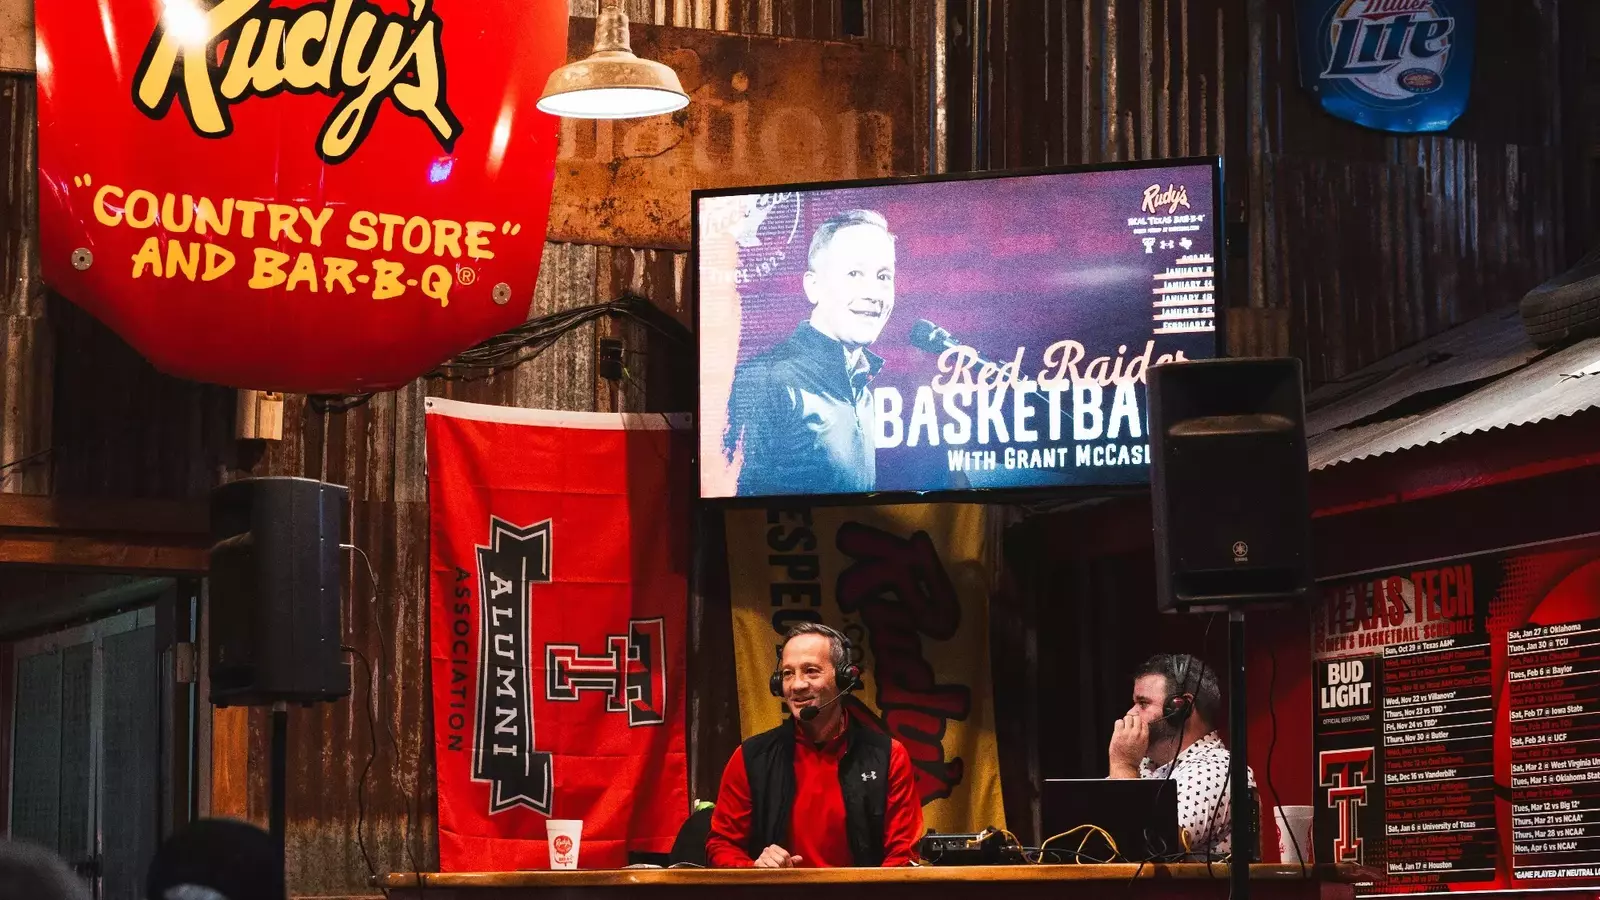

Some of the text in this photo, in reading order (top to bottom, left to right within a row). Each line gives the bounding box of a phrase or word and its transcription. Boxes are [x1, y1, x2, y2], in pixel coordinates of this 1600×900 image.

[1320, 15, 1456, 79] Lite
[1141, 183, 1191, 214] Rudy's
[131, 236, 236, 282] AND
[931, 344, 1028, 394] Red
[874, 377, 1151, 449] BASKETBA
[1320, 563, 1474, 636] TEXAS TECH
[1325, 619, 1474, 653] MEN'S BASKETBALL SCHEDULE
[1549, 623, 1582, 634] Oklahoma
[1555, 638, 1569, 647] TCU
[447, 566, 472, 752] ASSOCIATION
[489, 571, 518, 757] ALUMNI
[1327, 660, 1364, 686] BUD
[1552, 665, 1573, 675] Baylor
[1321, 682, 1372, 709] LIGHT
[1322, 717, 1341, 725] OFFICIAL
[1352, 714, 1370, 722] SPONSOR
[1536, 708, 1543, 716] 17
[1551, 707, 1566, 715] Iowa
[1567, 705, 1583, 713] State
[1554, 733, 1567, 741] UCF
[1550, 761, 1567, 769] West
[1567, 758, 1591, 769] Virginia
[1556, 773, 1586, 782] Oklahoma
[1422, 821, 1451, 830] University
[1460, 820, 1476, 828] Texas
[1428, 861, 1452, 869] Houston
[1534, 870, 1556, 878] PLAYED
[1557, 869, 1565, 877] AT
[1566, 868, 1594, 877] NEUTRAL
